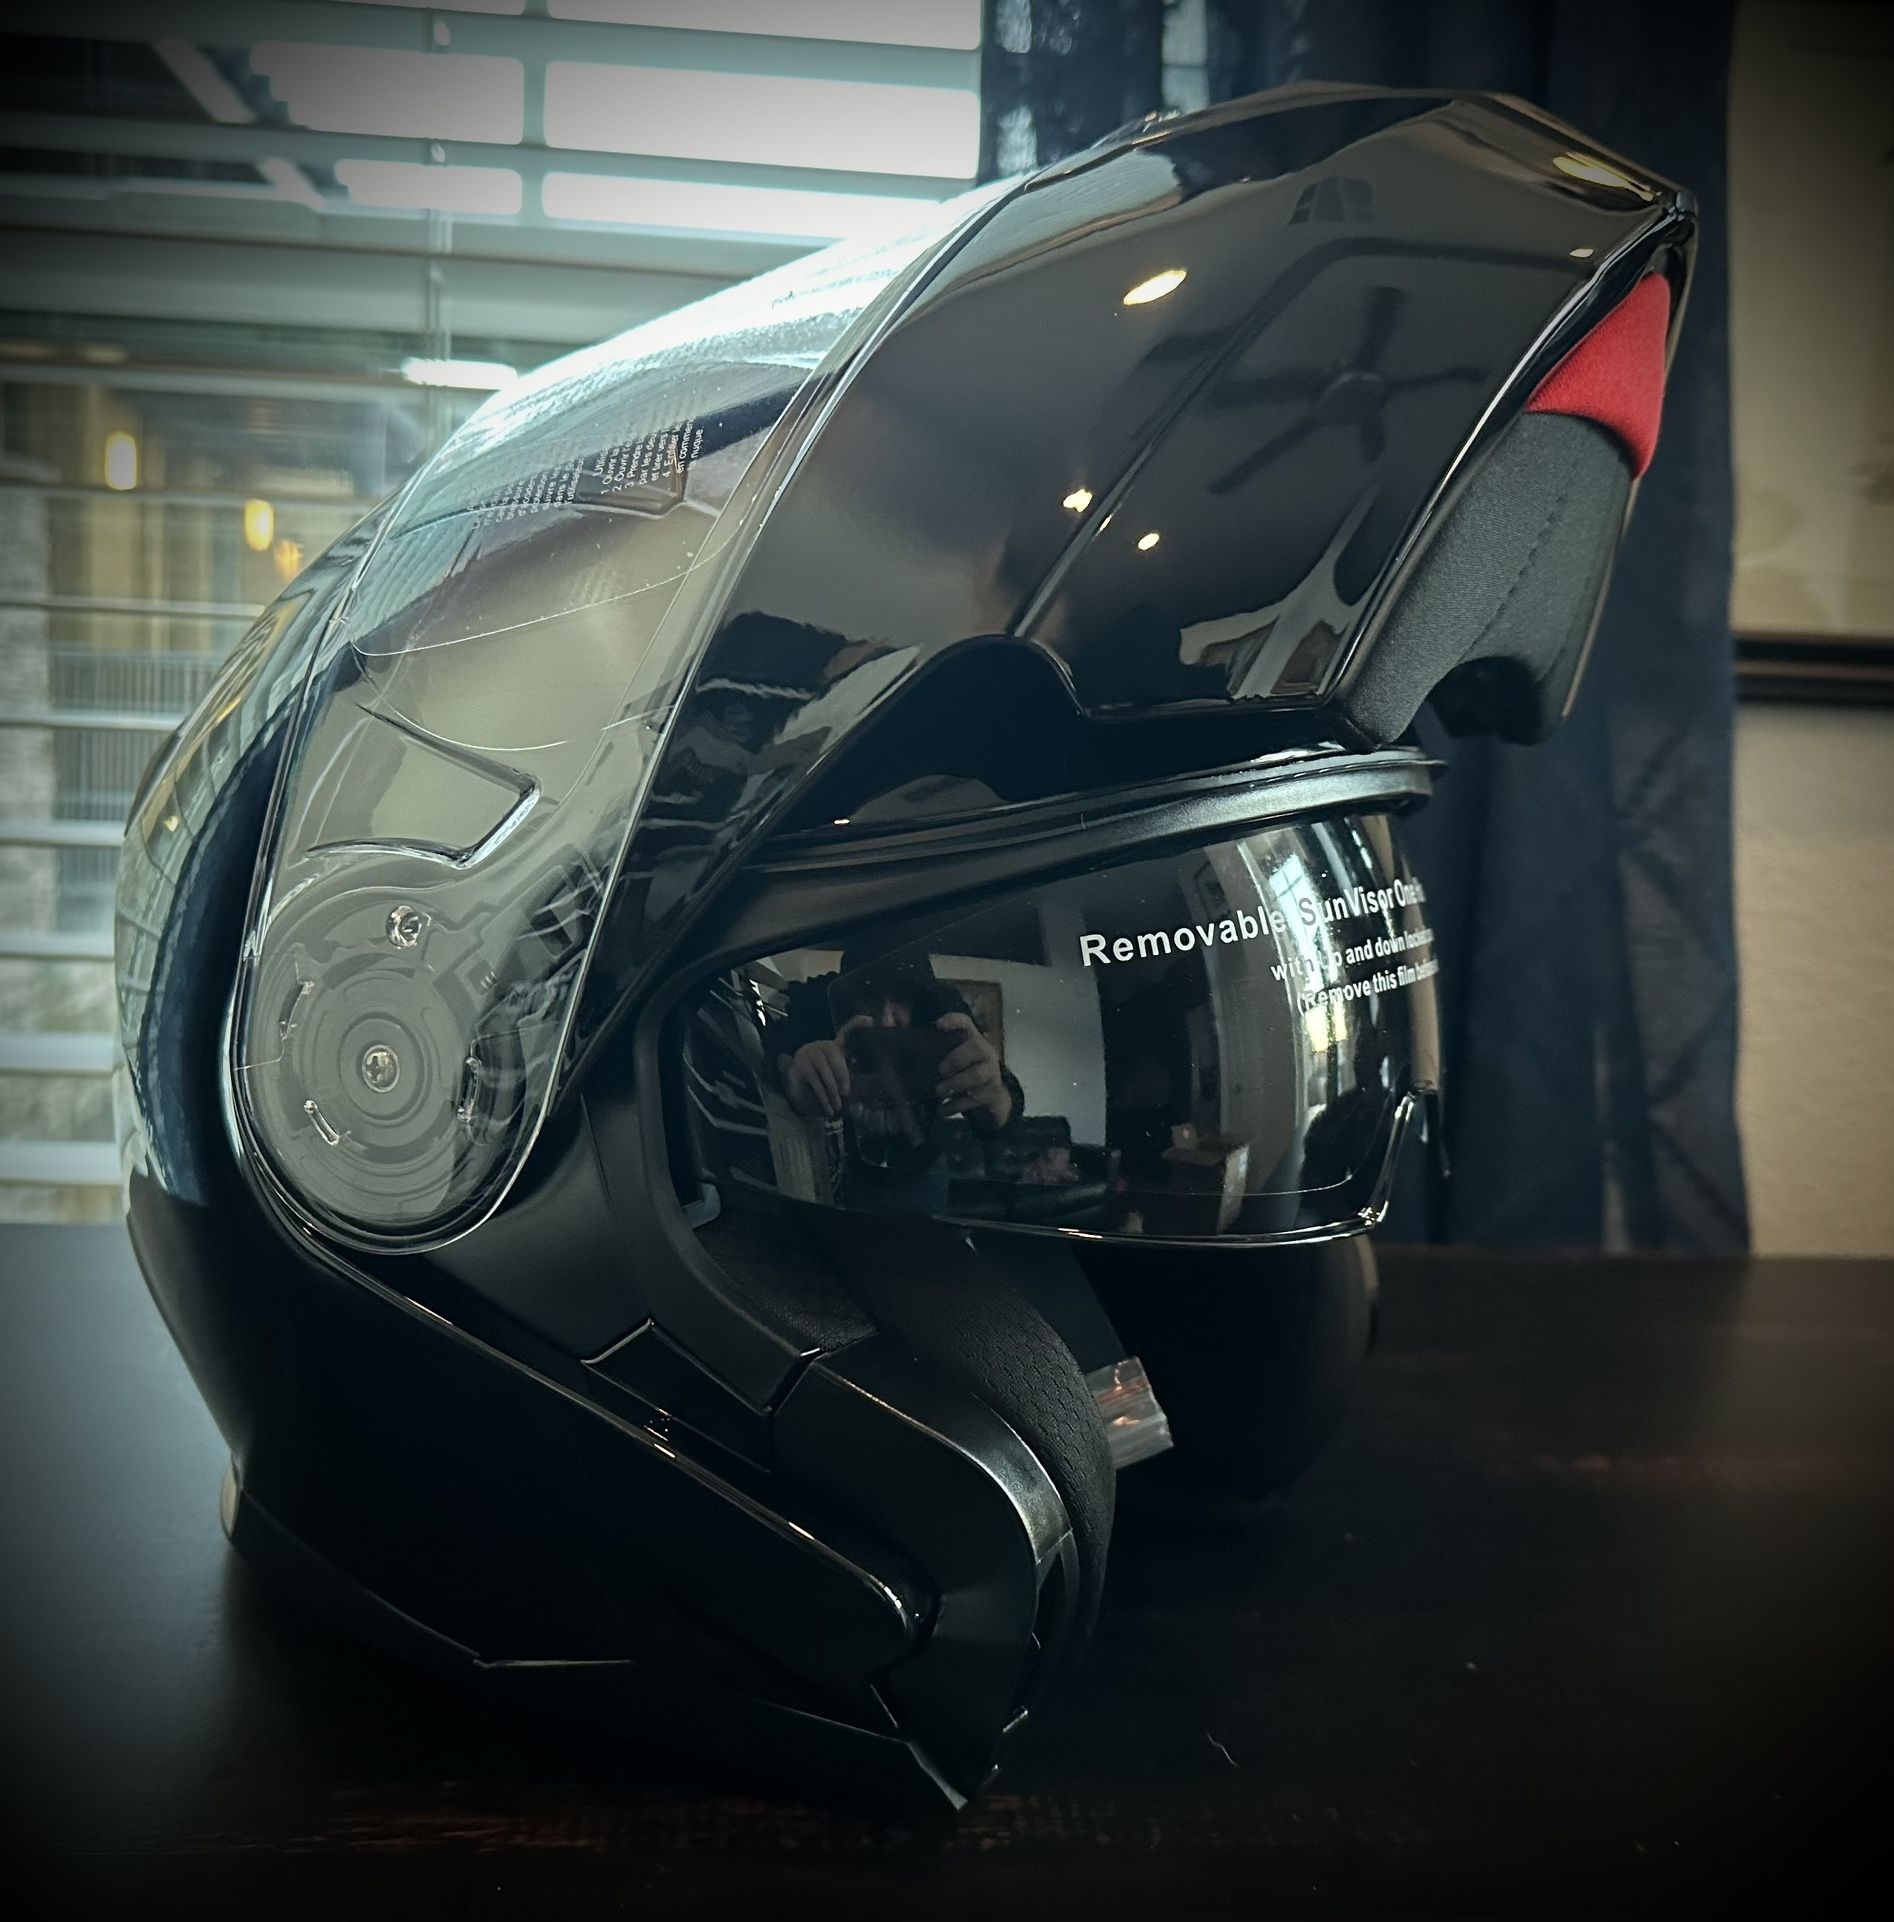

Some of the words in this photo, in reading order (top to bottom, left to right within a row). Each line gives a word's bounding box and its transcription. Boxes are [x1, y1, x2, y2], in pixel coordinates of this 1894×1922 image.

[658, 433, 669, 453] vers
[615, 453, 629, 482] Ouvrir
[626, 444, 643, 479] Prendre
[641, 451, 653, 468] les
[652, 453, 663, 471] tirer
[676, 460, 685, 474] en
[639, 469, 649, 485] par
[651, 472, 660, 482] et
[1080, 906, 1286, 967] Removable
[1346, 939, 1374, 965] and
[1375, 936, 1406, 958] down
[1297, 979, 1370, 1017] (Remove
[1373, 970, 1398, 994] this
[1397, 963, 1417, 987] film
